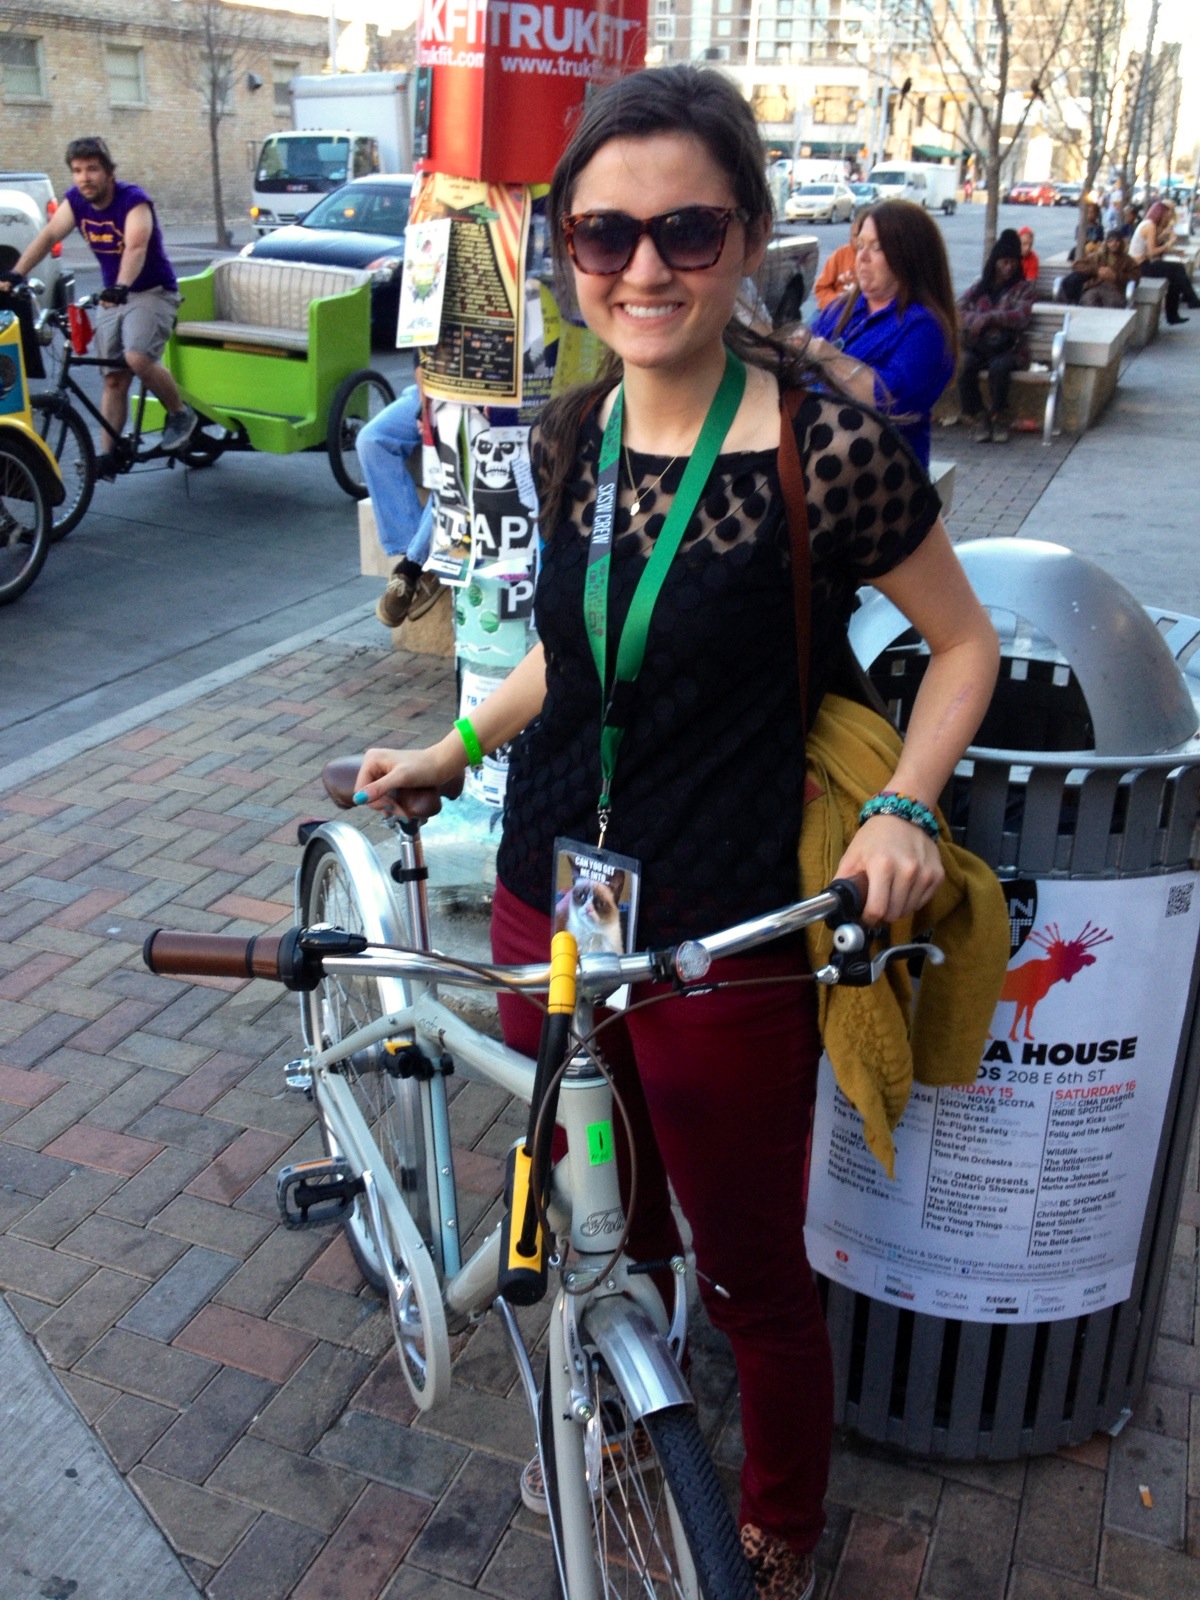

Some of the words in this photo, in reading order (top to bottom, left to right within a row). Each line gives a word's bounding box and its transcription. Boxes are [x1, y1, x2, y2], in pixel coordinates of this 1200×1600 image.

[488, 1, 631, 60] TRUKFIT
[595, 482, 615, 513] SXSW
[591, 513, 612, 545] CREW
[575, 856, 589, 868] CAN
[589, 860, 603, 872] YOU
[603, 864, 616, 876] GET
[580, 868, 590, 878] ME
[1021, 1036, 1138, 1066] HOUSE
[1007, 1070, 1039, 1084] 208
[1043, 1072, 1052, 1084] E
[1057, 1071, 1083, 1083] 6th
[1088, 1068, 1106, 1082] ST
[1000, 1087, 1014, 1098] 15
[1055, 1082, 1123, 1100] SATURDAY
[940, 1099, 997, 1113] SHOWCASE
[968, 1095, 995, 1105] NOVA
[998, 1099, 1035, 1109] SCOTIA
[1078, 1099, 1098, 1107] CIMA
[1100, 1092, 1135, 1106] presents
[938, 1109, 961, 1118] Jenn
[963, 1113, 989, 1123] Grant
[1052, 1108, 1075, 1116] INDIE
[1077, 1102, 1123, 1115] SPOTLIGHT
[1051, 1118, 1084, 1127] Teenage
[1086, 1116, 1106, 1125] Kicks
[936, 1129, 953, 1138] Ben
[979, 1126, 1008, 1137] Safety
[1071, 1128, 1086, 1137] and
[1087, 1127, 1100, 1135] the
[934, 1149, 951, 1159] Tom
[953, 1153, 969, 1162] Fun
[971, 1155, 1012, 1167] Orchestra
[1045, 1158, 1060, 1166] The
[1062, 1154, 1104, 1165] Wilderness
[930, 1175, 948, 1185] The
[950, 1180, 986, 1191] Ontario
[988, 1184, 1035, 1195] Showcase
[985, 1176, 1028, 1186] presents
[929, 1186, 980, 1200] Whitehorse
[1060, 1199, 1070, 1207] BC
[1073, 1190, 1117, 1206] SHOWCASE
[928, 1195, 944, 1204] The
[947, 1199, 996, 1212] Wilderness
[1036, 1208, 1080, 1218] Christopher
[925, 1221, 941, 1231] The
[947, 1216, 973, 1227] Young
[976, 1220, 1003, 1230] Things
[1033, 1239, 1047, 1247] The
[927, 1252, 952, 1263] SXSW
